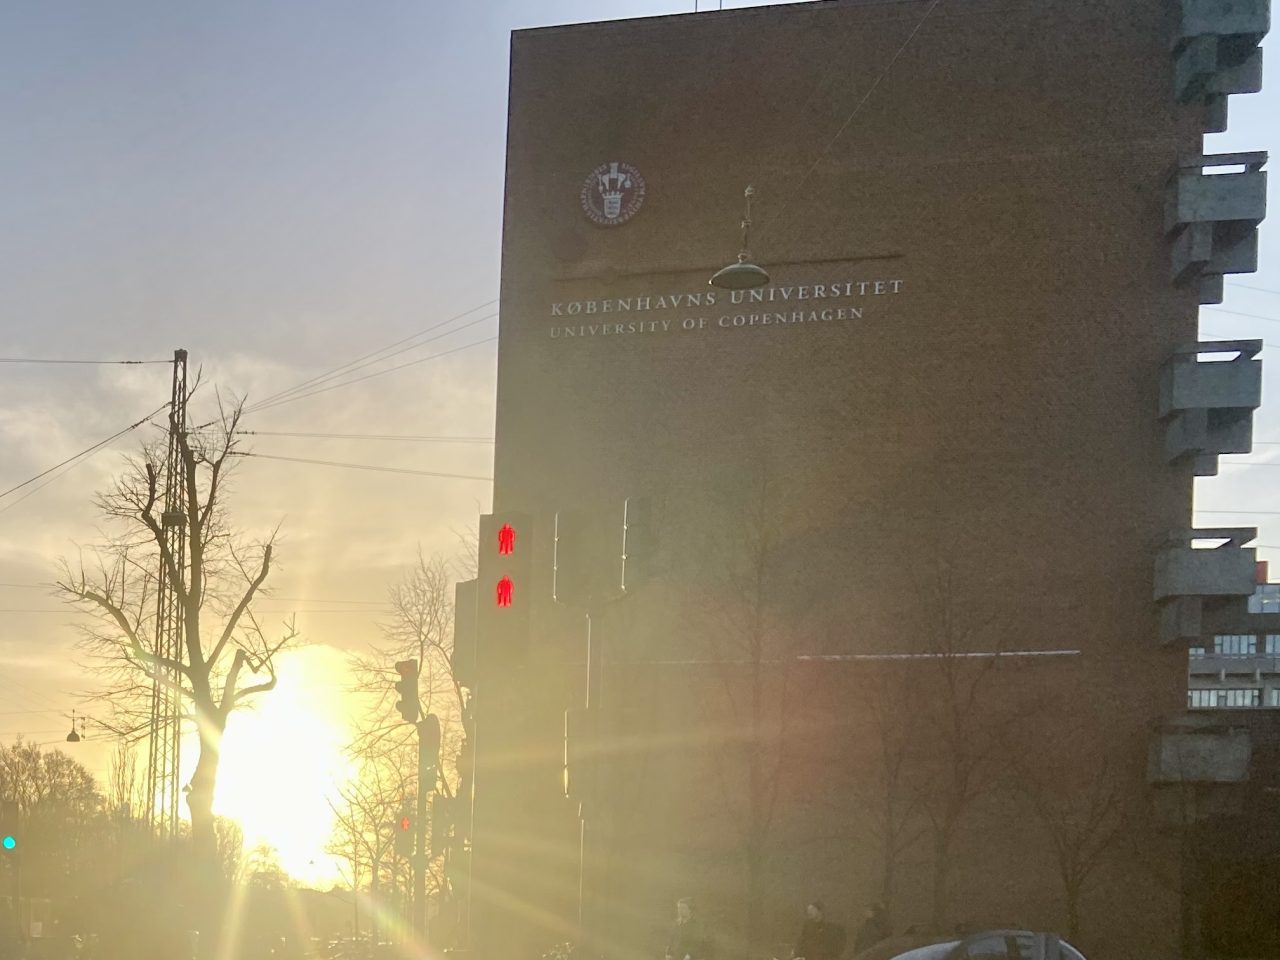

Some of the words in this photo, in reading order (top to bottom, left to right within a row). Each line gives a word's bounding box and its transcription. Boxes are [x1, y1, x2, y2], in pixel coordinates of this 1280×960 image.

[550, 291, 717, 316] KØBENHAVNS
[730, 279, 904, 304] UNIVERSITET
[550, 319, 672, 338] UNIVERSITY
[682, 317, 710, 330] OF
[718, 307, 864, 328] COPENHAGEN
